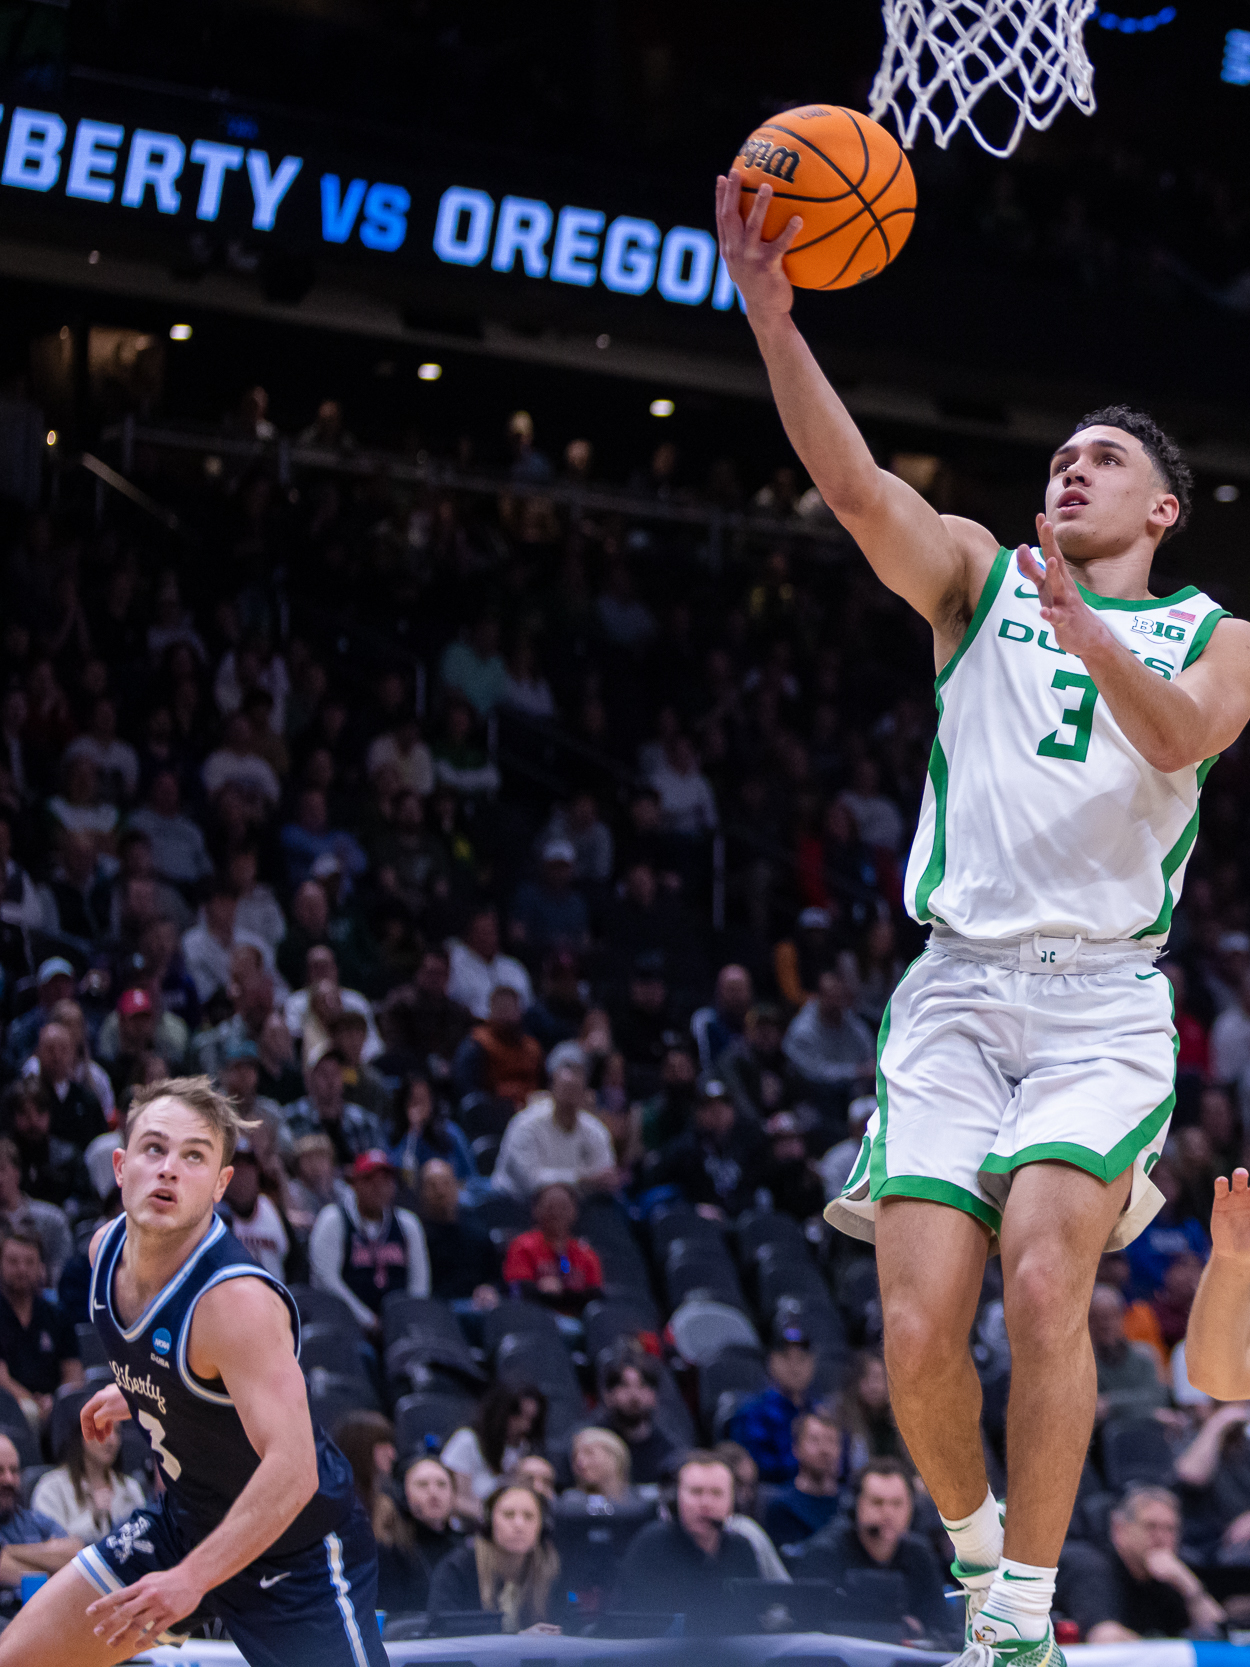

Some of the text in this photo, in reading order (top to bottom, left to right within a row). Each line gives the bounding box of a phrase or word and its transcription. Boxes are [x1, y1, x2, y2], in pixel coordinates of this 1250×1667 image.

[0, 103, 303, 232] BERTY
[320, 173, 411, 252] VS
[1036, 669, 1099, 763] 3
[109, 1360, 167, 1415] Liberty
[138, 1409, 182, 1482] 3
